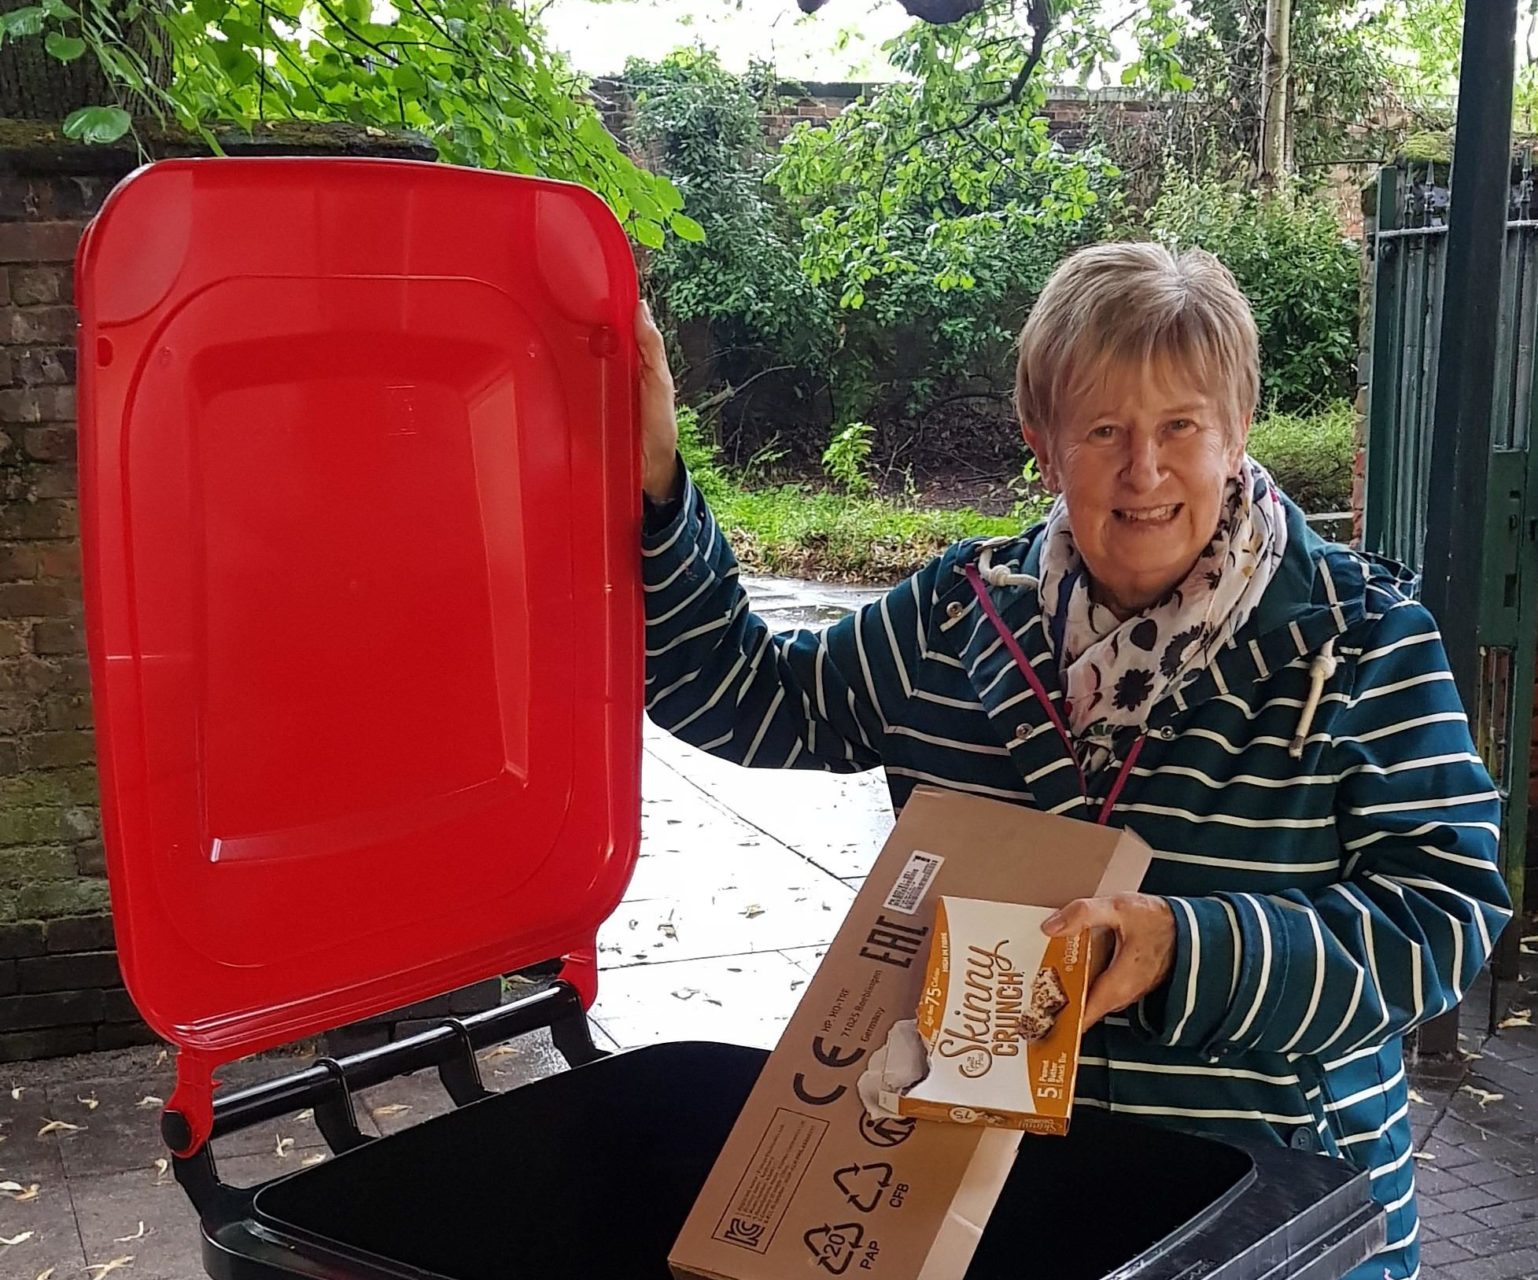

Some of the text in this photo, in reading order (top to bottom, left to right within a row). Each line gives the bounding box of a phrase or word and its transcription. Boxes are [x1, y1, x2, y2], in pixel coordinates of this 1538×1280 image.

[924, 986, 942, 1006] 75
[939, 939, 1012, 1078] Skinny
[841, 1010, 861, 1038] 71025
[860, 1006, 886, 1042] Germany
[991, 971, 1024, 1056] CRUNCH
[793, 1036, 867, 1106] CE
[1036, 1087, 1058, 1099] 5
[889, 1183, 910, 1209] CFB
[823, 1232, 847, 1258] 20
[859, 1240, 881, 1270] PAP
